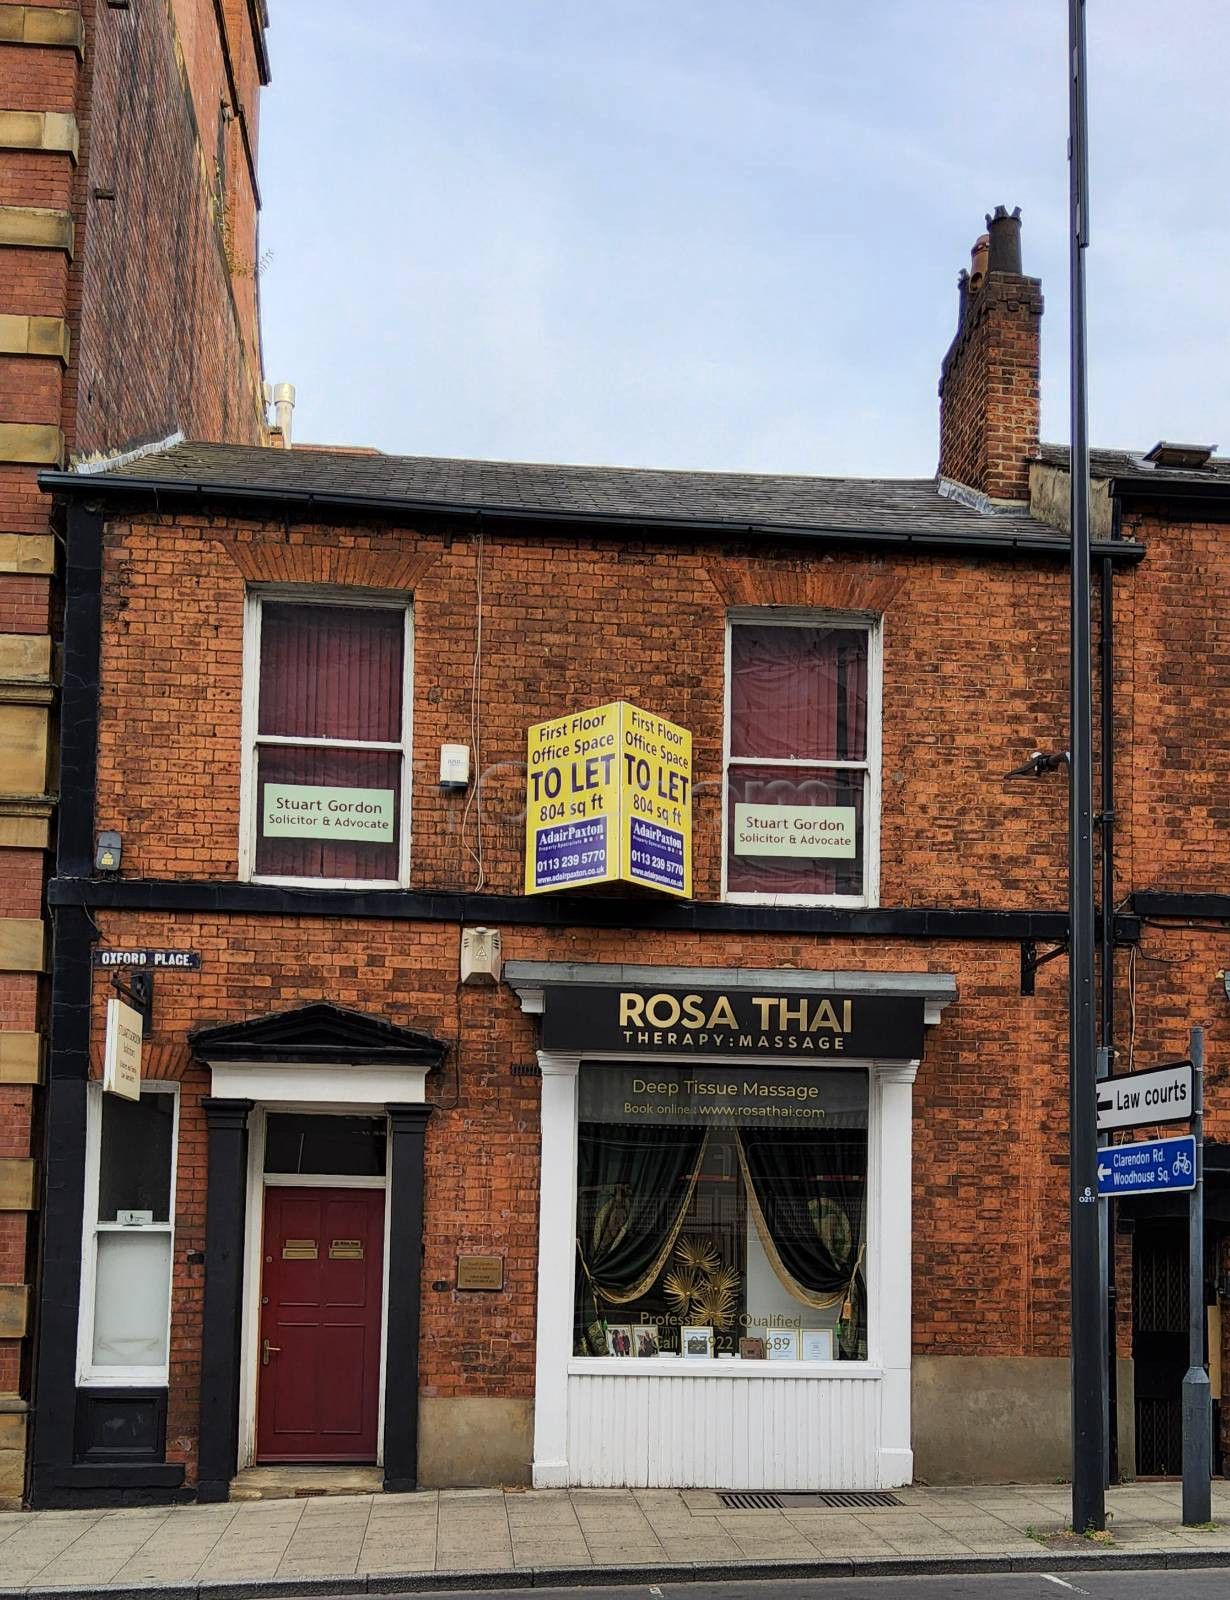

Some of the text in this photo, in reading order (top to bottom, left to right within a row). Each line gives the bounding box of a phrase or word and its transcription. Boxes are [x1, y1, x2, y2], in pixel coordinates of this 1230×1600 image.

[540, 713, 606, 742] First Floor
[631, 712, 683, 746] First Floor
[532, 733, 614, 764] Office Space
[625, 731, 689, 770] Office Space
[531, 767, 561, 802] TO
[572, 753, 615, 793] LET
[624, 752, 651, 791] TO
[658, 766, 689, 805] LET
[276, 797, 382, 814] Stuart Gordon
[540, 794, 603, 821] 804 sq ft
[633, 795, 682, 826] 804 sq ft
[269, 814, 389, 830] Solicitor & Advocate
[746, 816, 844, 832] Stuart Gordon
[538, 824, 604, 846] AdairPaxton
[633, 822, 682, 849] AdairPaxton
[739, 833, 851, 846] Solicitor & Advocate
[538, 844, 557, 852] Property
[537, 849, 605, 872] 0113 239 5770
[632, 849, 683, 876] 0113 239 5770
[537, 865, 605, 884] www.adairpaxton.co.uk
[102, 952, 147, 966] OXFORD
[618, 992, 852, 1033] ROSA THAI
[633, 1079, 819, 1100] Deep Tissue Massage
[1117, 1079, 1187, 1111] Law courts
[624, 1102, 653, 1114] Book
[657, 1103, 690, 1115] online
[700, 1105, 825, 1118] www.rosathai.com
[1113, 1148, 1165, 1166] Clarendon Rd.
[1113, 1167, 1170, 1185] Woodhouse Sq.
[1084, 1187, 1092, 1197] 6
[739, 1314, 802, 1328] Qualified
[651, 1336, 679, 1350] Call
